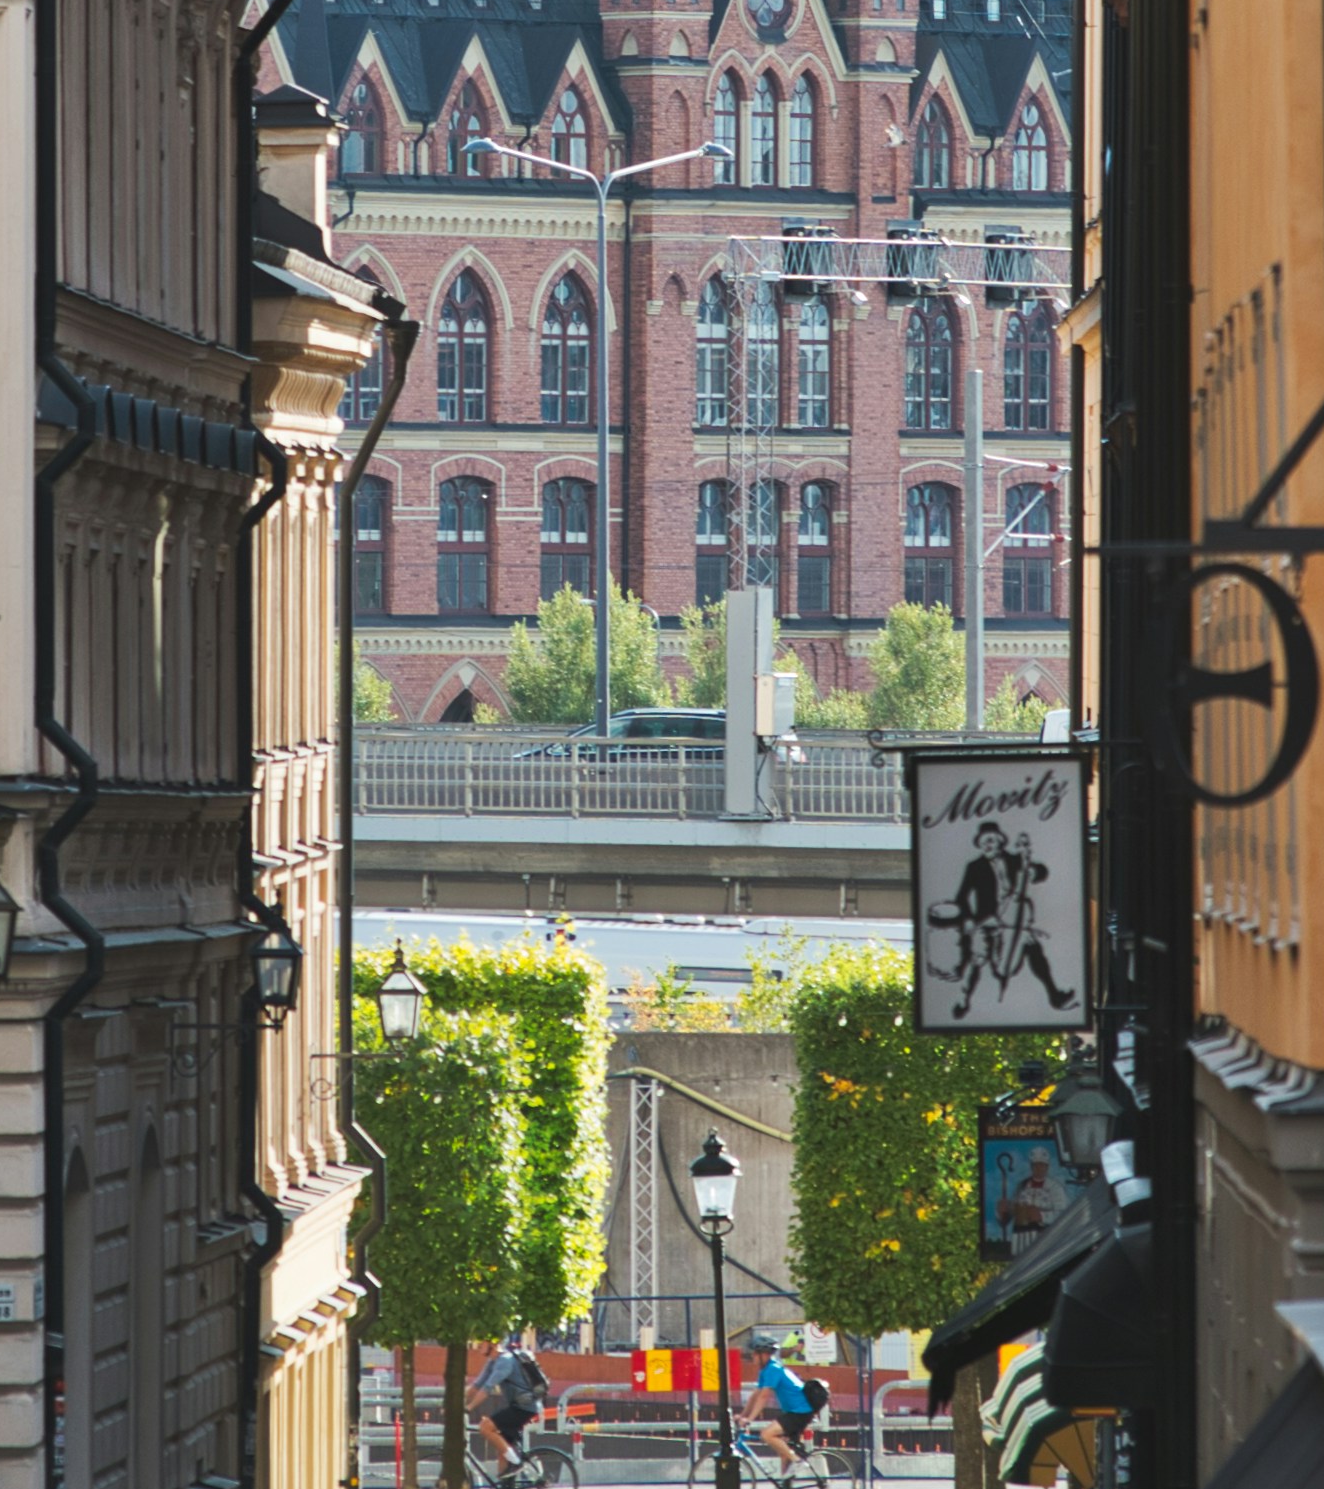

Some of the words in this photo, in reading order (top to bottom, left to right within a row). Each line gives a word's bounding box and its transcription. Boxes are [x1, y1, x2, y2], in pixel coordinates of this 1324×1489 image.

[921, 768, 1069, 829] Movitz
[1020, 1113, 1049, 1123] THE
[987, 1125, 1044, 1136] BISHOPS
